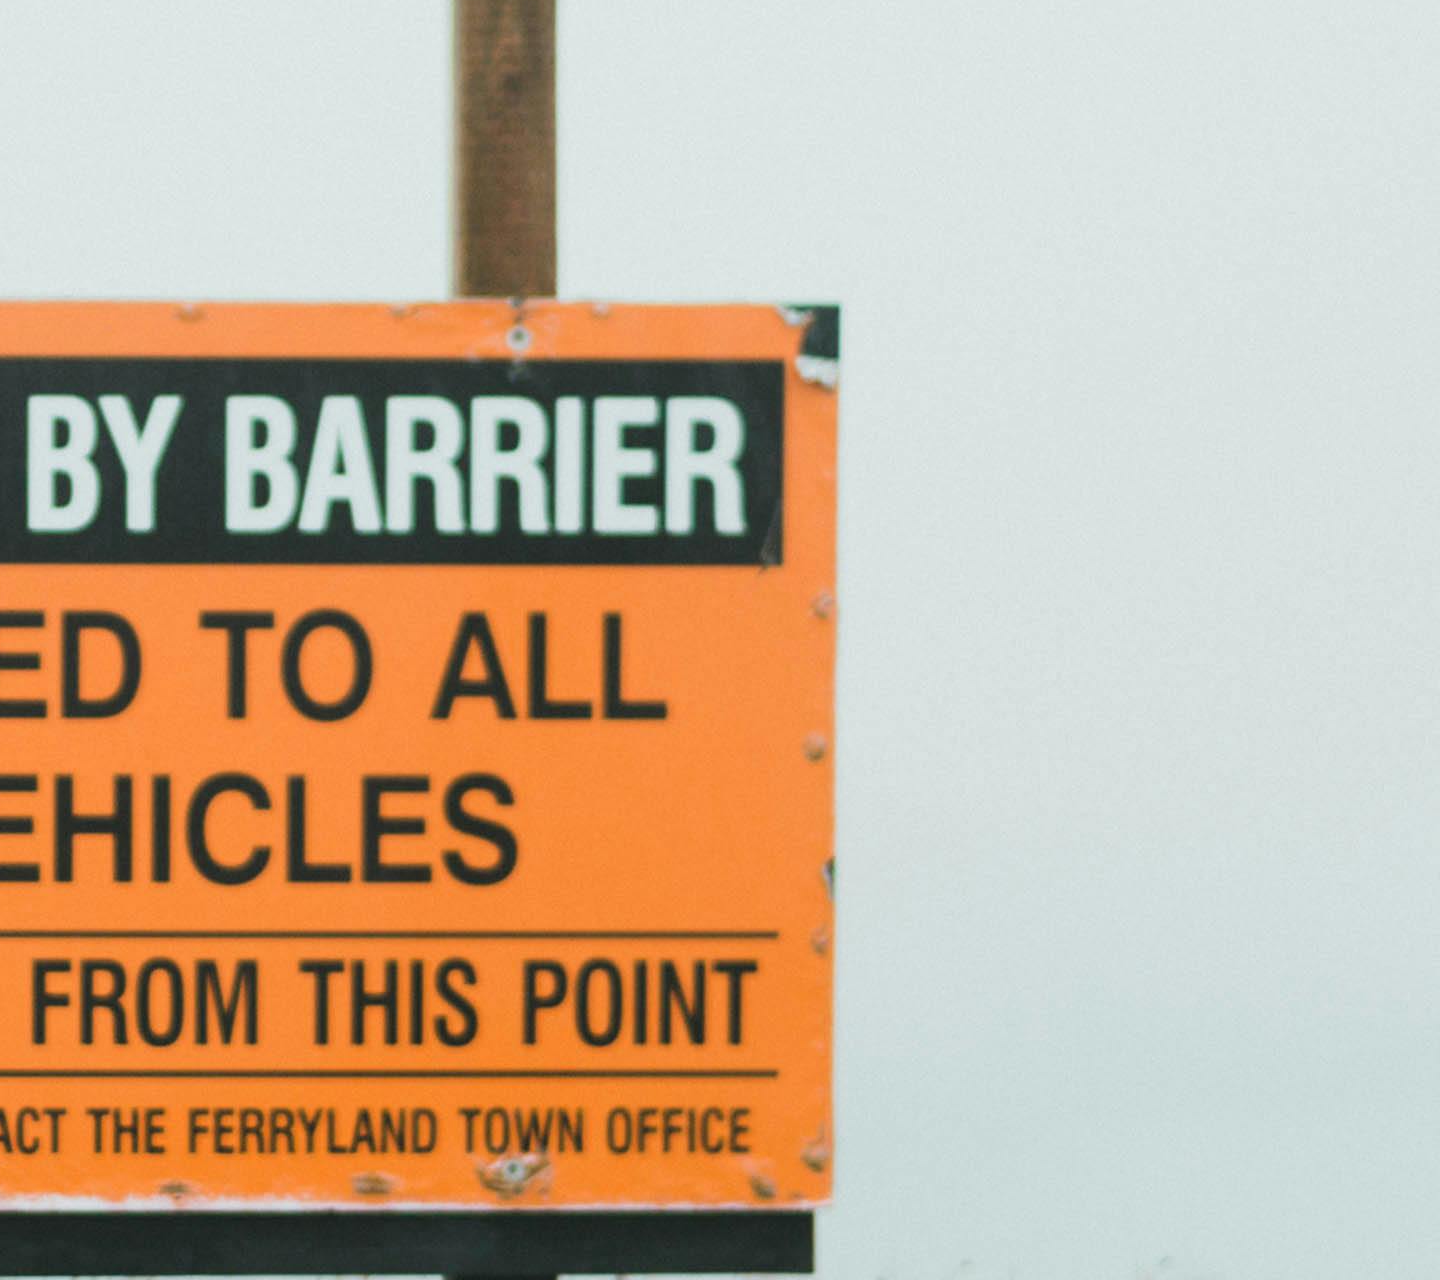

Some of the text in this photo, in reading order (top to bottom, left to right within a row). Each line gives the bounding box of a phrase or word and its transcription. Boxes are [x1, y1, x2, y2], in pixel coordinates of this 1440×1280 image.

[26, 394, 181, 531] BY
[226, 394, 745, 535] BARRIER
[199, 608, 374, 723] TO
[431, 611, 668, 721] ALL
[32, 957, 259, 1048] FROM
[299, 957, 479, 1048] THIS
[523, 958, 759, 1048] POINT
[87, 1108, 166, 1155] THE
[189, 1108, 437, 1155] FERRYLAND
[459, 1107, 584, 1155] TOWN
[607, 1107, 750, 1155] OFFICE
